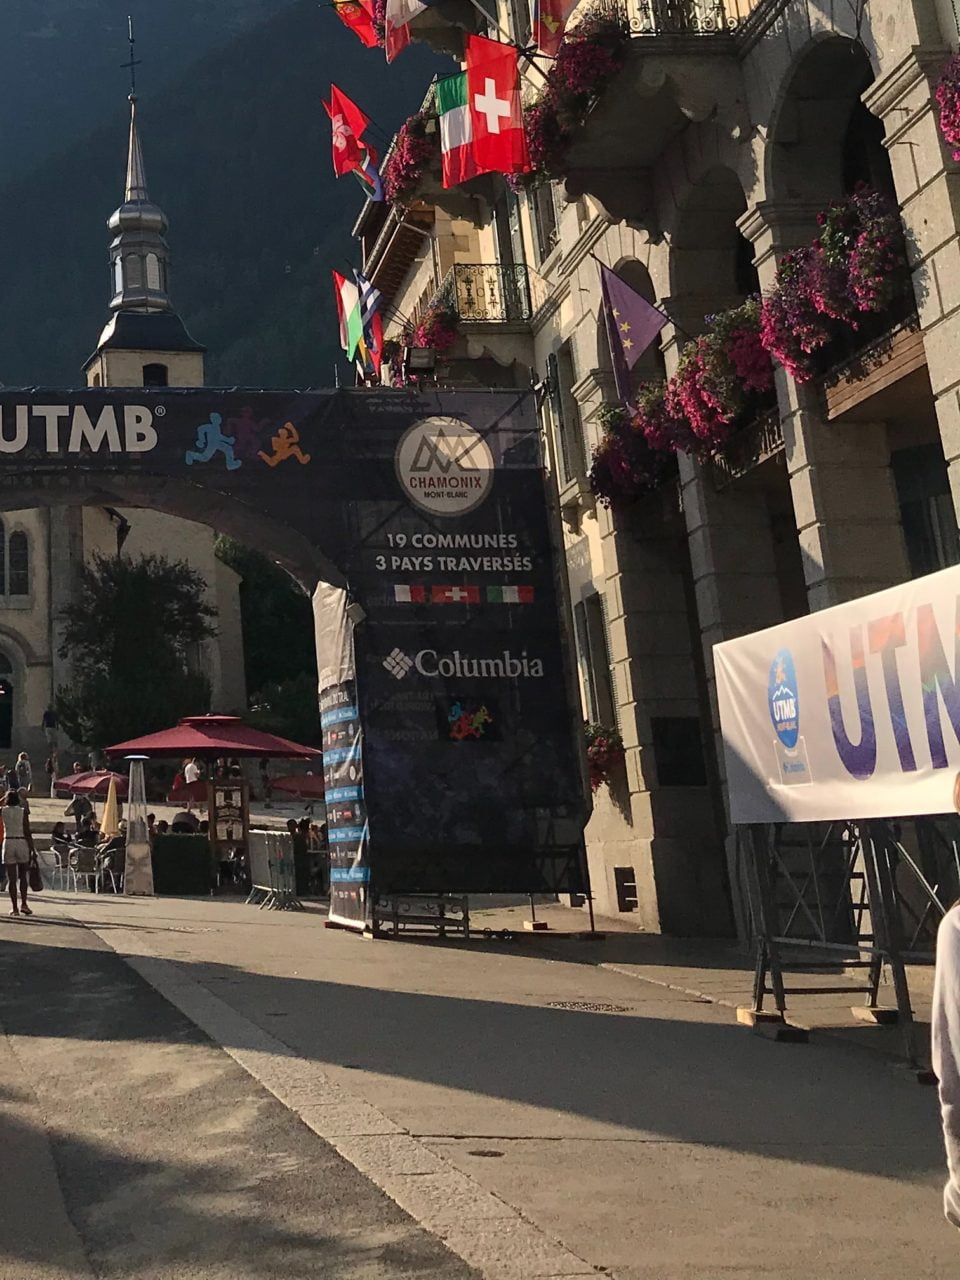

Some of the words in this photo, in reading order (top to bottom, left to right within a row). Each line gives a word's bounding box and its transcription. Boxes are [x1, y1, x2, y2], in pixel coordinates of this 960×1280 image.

[409, 476, 483, 489] CHAMONIX
[387, 534, 408, 549] 19
[411, 533, 518, 549] COMMUNES
[375, 555, 387, 570] 3
[391, 556, 434, 571] PAYS
[437, 553, 533, 571] TRAVERSÉS
[415, 650, 544, 678] Columbia
[773, 698, 797, 721] UTMB
